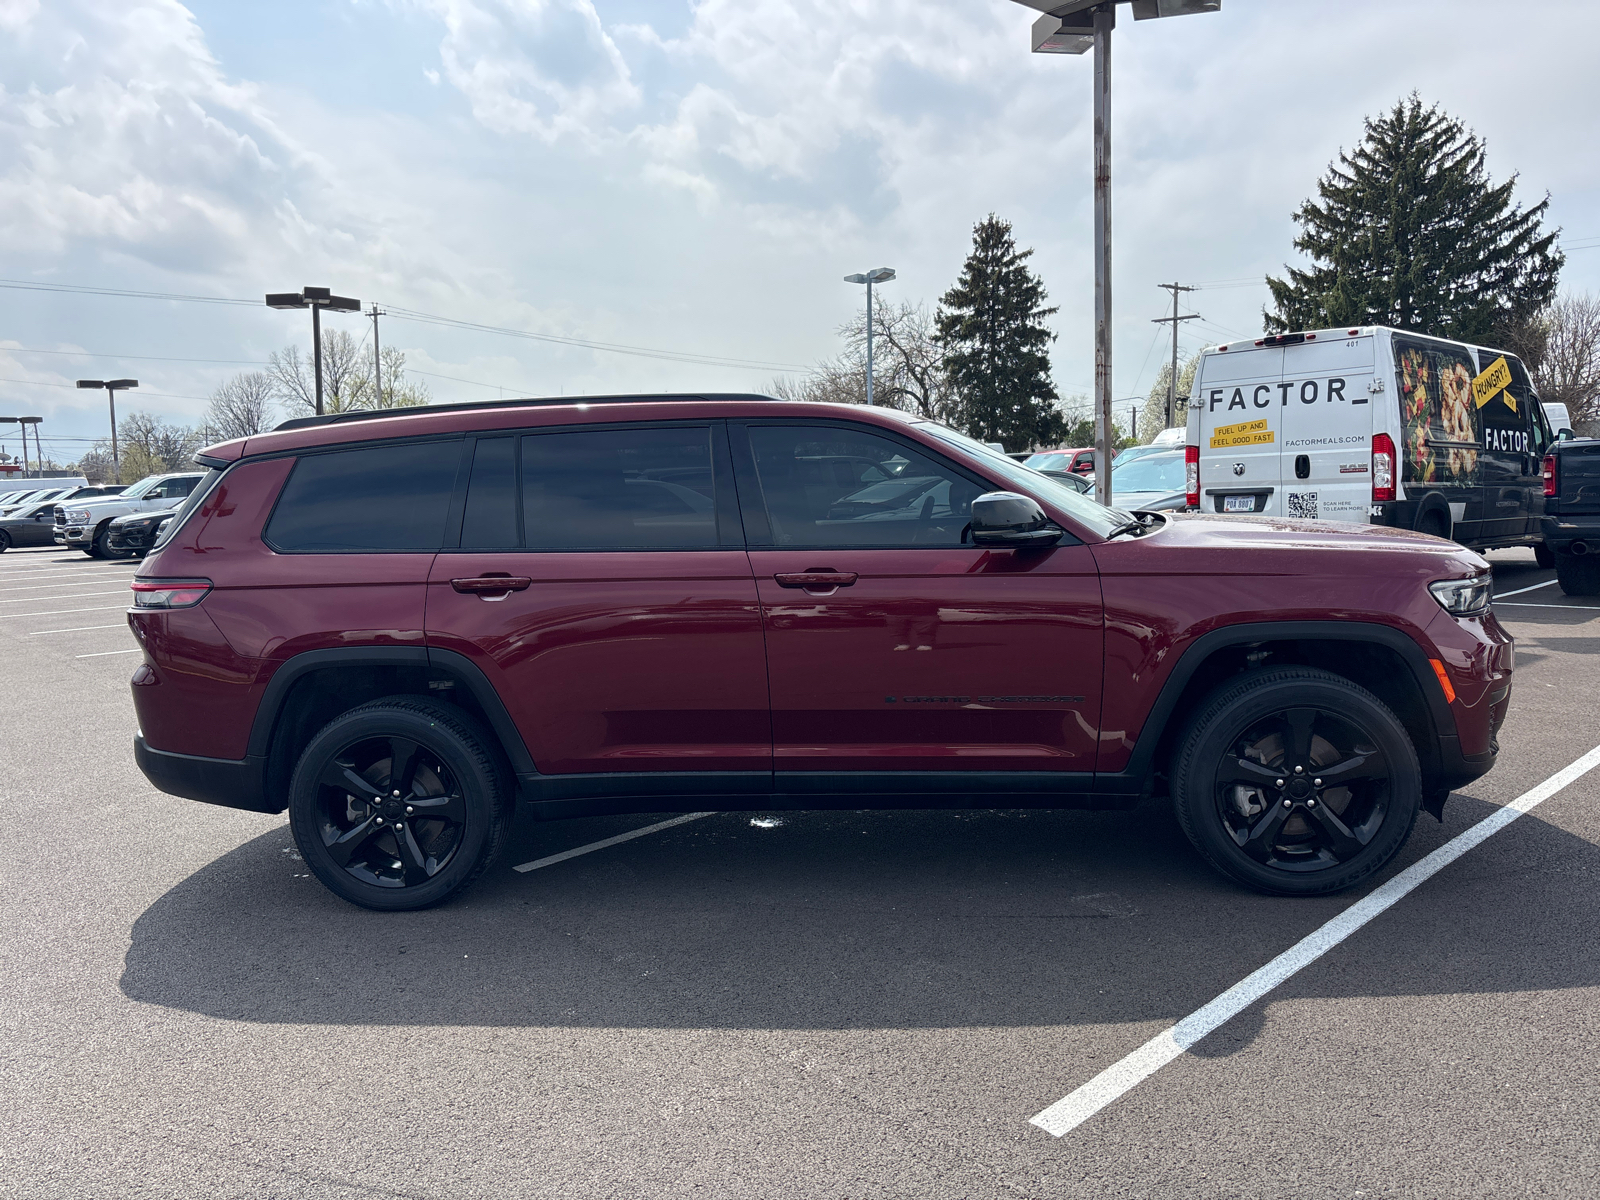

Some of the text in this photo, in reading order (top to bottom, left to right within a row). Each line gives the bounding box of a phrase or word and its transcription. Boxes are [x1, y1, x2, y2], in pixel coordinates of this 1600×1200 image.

[1476, 363, 1508, 399] HUNGRY?
[1218, 428, 1235, 436] FUEL
[1250, 422, 1264, 430] AND
[1213, 433, 1271, 446] FEEL GOOD FAST
[1285, 436, 1365, 447] FACTORMEALS.COM
[1485, 428, 1529, 452] FACTOR
